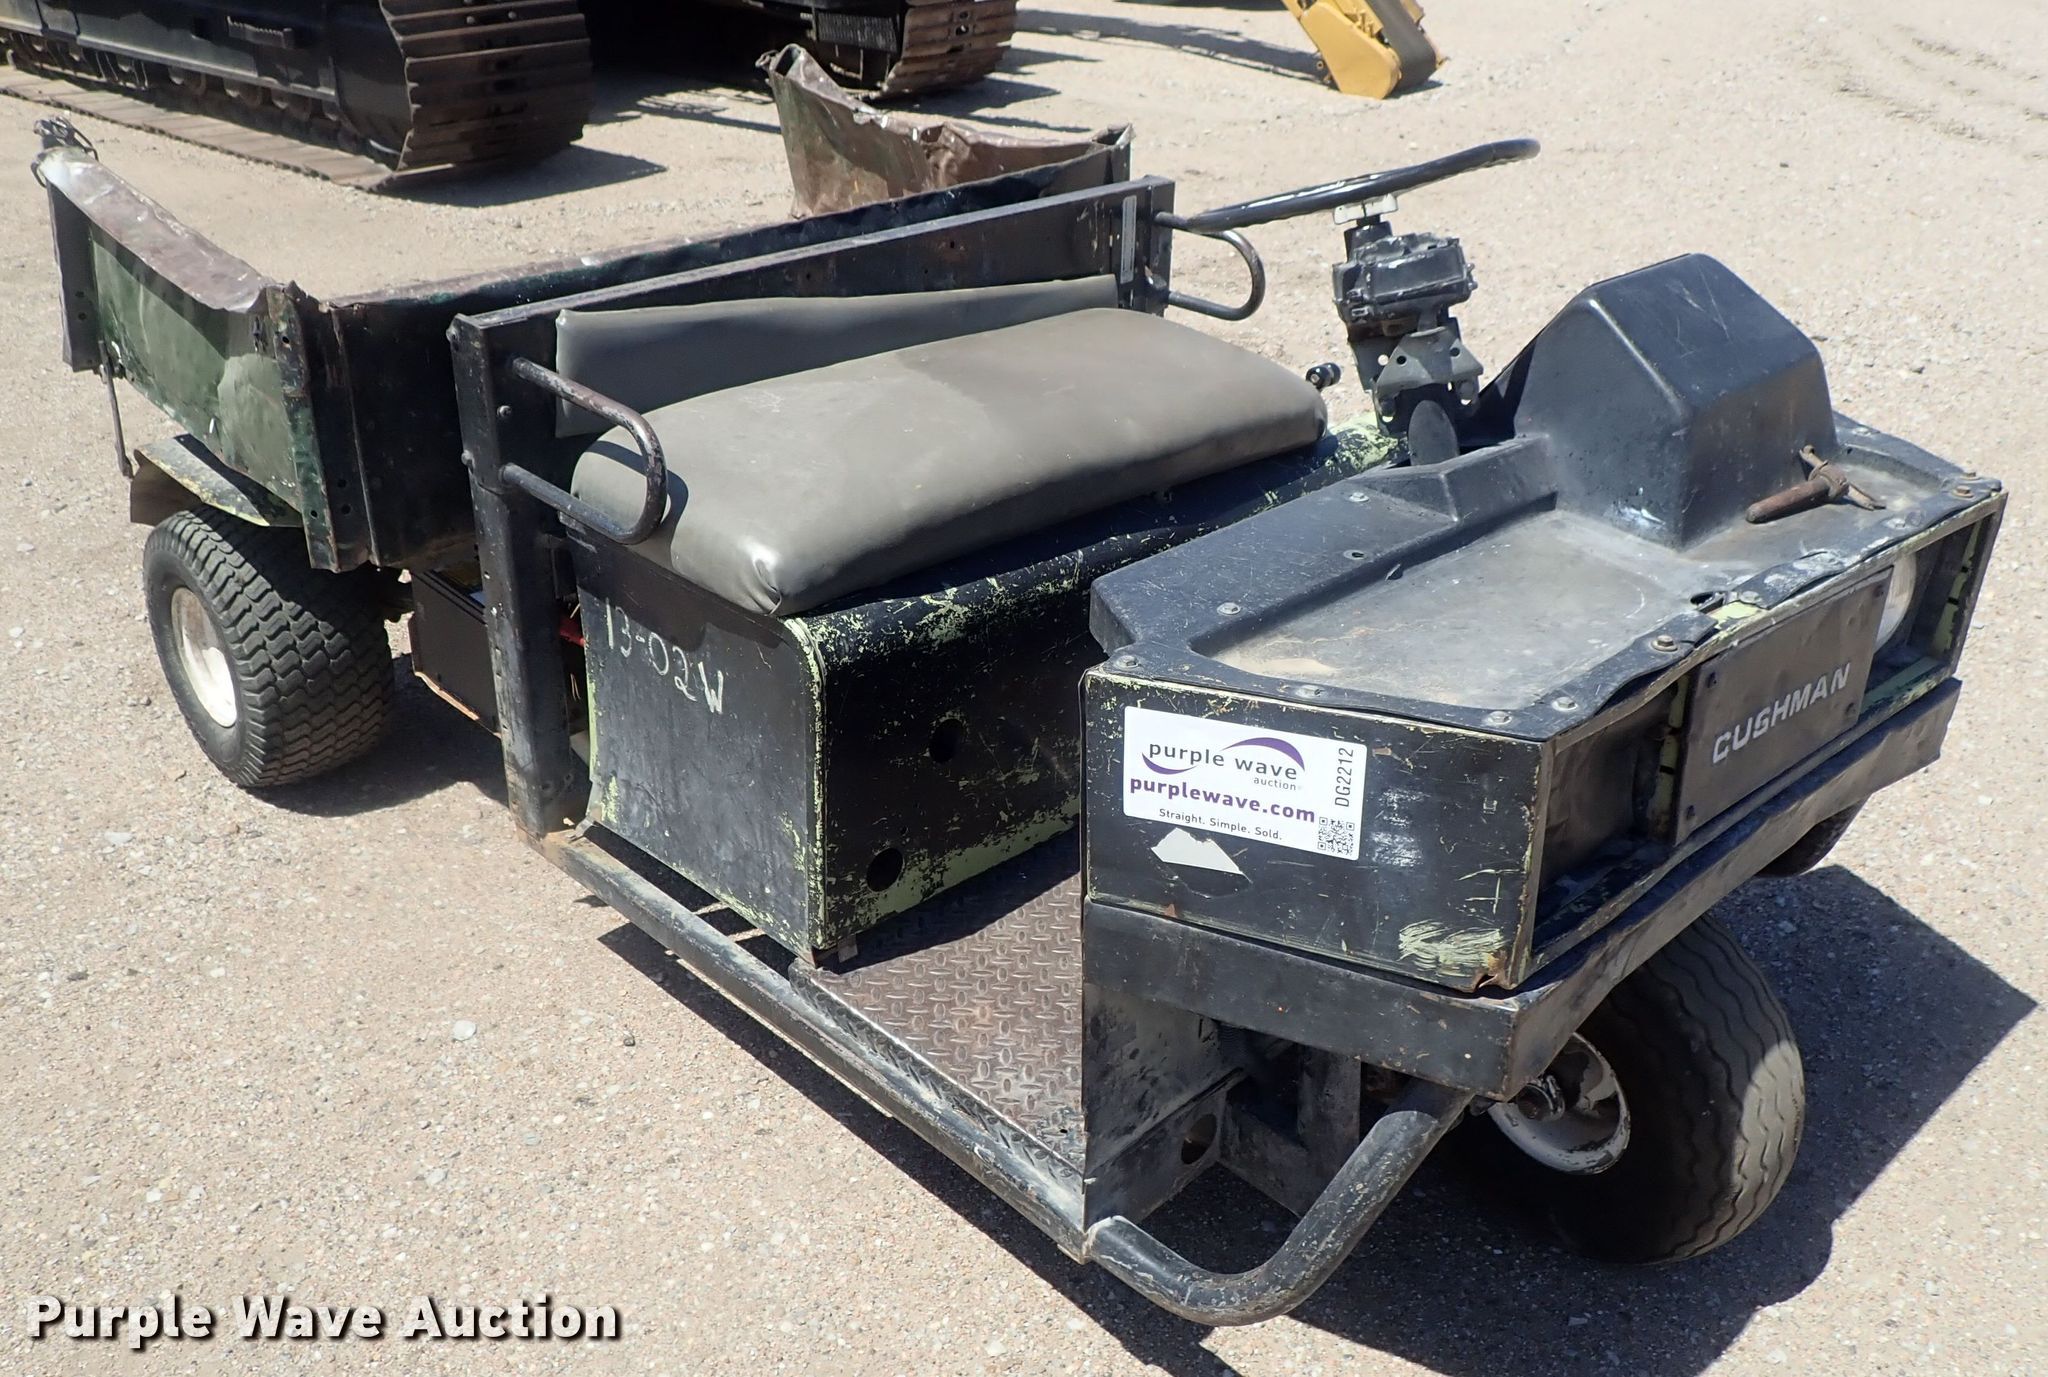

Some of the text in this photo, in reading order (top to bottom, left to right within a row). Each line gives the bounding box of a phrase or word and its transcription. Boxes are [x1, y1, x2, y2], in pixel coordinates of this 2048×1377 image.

[1712, 662, 1851, 764] CUSHMAN
[1149, 743, 1297, 780] purple wave
[1334, 747, 1354, 808] DG2212
[1130, 777, 1316, 823] purplewave.com
[1253, 776, 1297, 791] auction
[1159, 808, 1282, 840] Straight. Simple. Sold.
